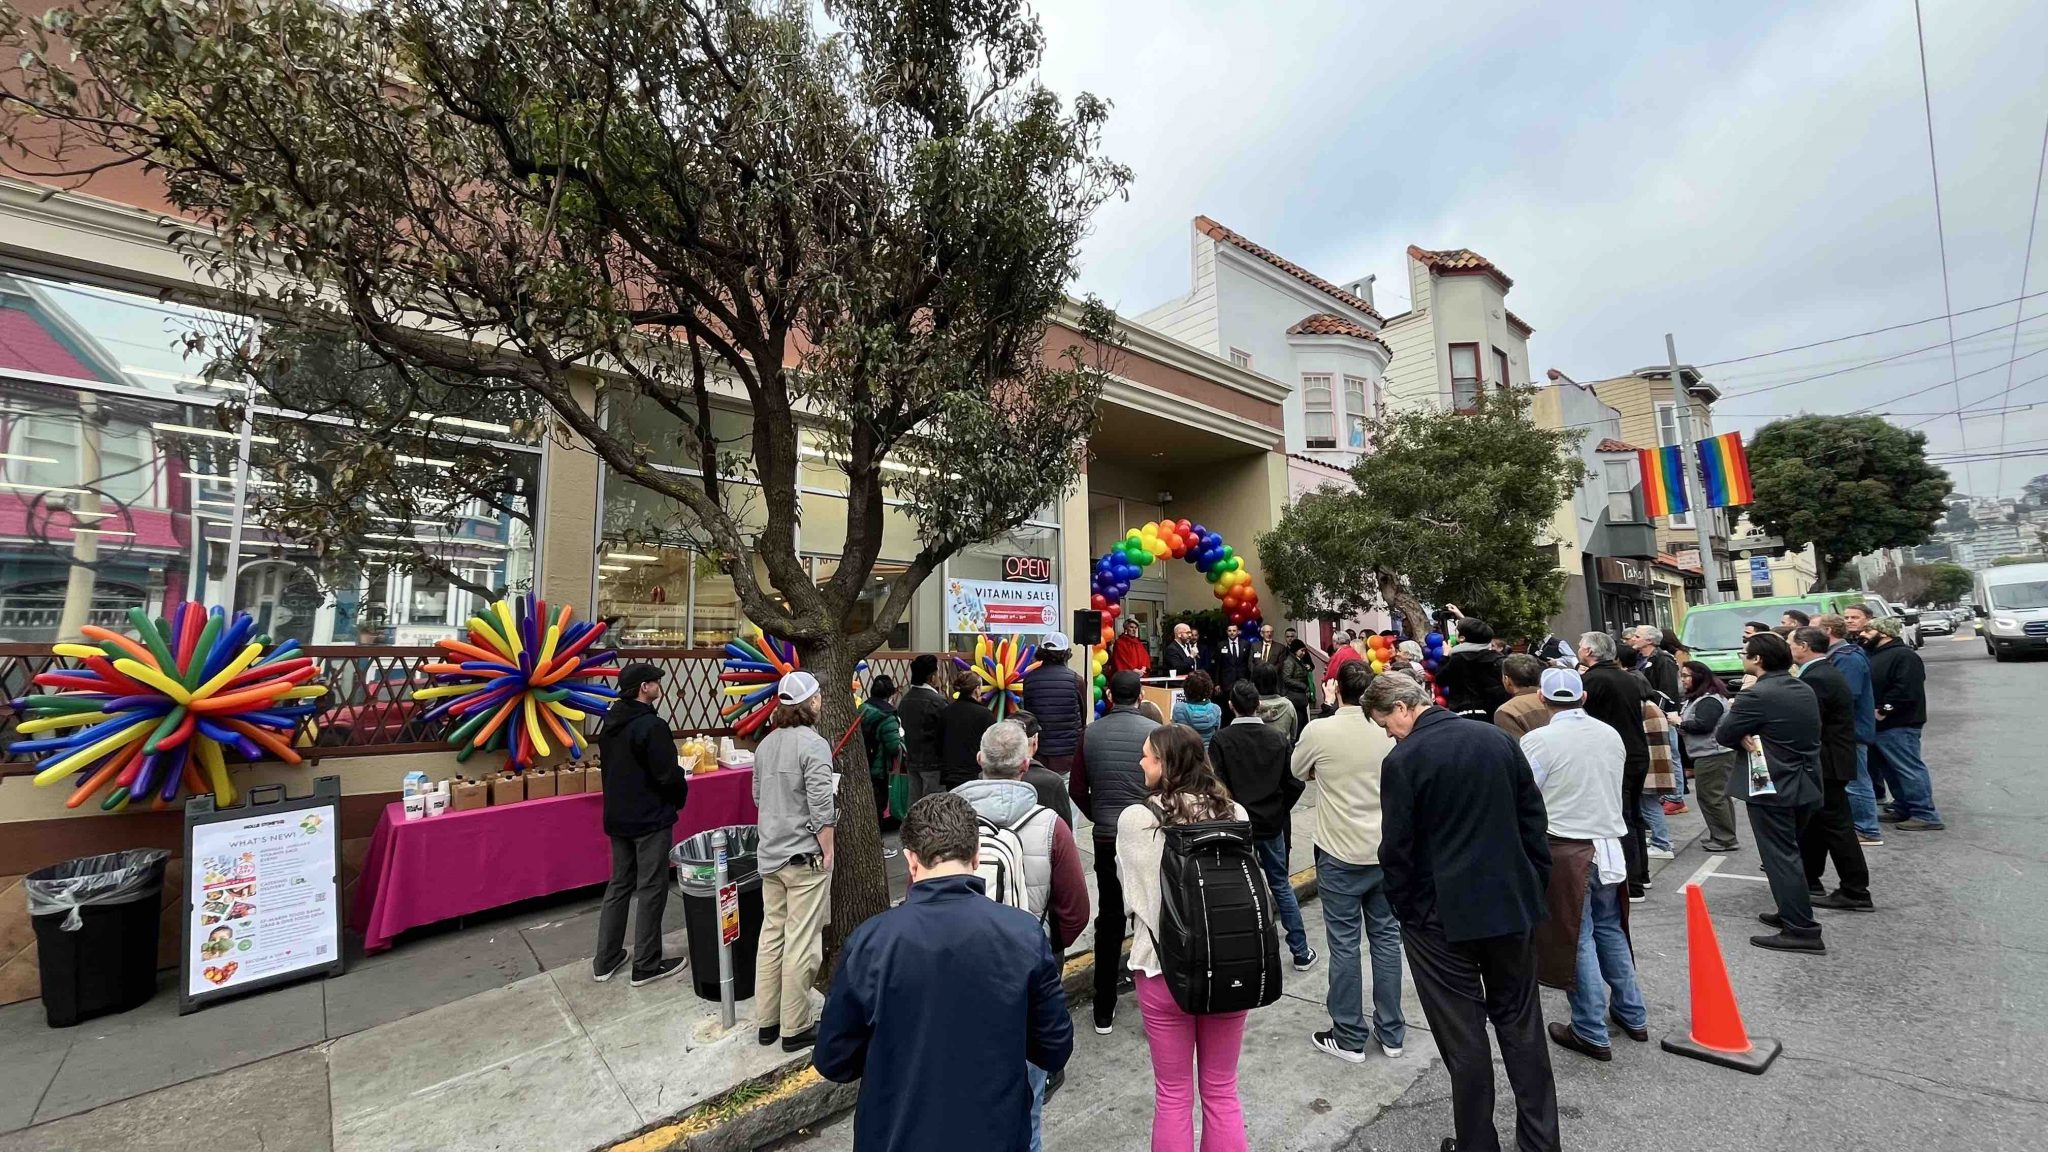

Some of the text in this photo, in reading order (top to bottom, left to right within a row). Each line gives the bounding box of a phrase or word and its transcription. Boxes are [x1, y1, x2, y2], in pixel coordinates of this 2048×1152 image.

[1006, 557, 1050, 578] OPEN
[975, 587, 1054, 601] VITAMIN SALE!
[229, 836, 267, 848] WHAT'S
[270, 832, 296, 842] NEW!
